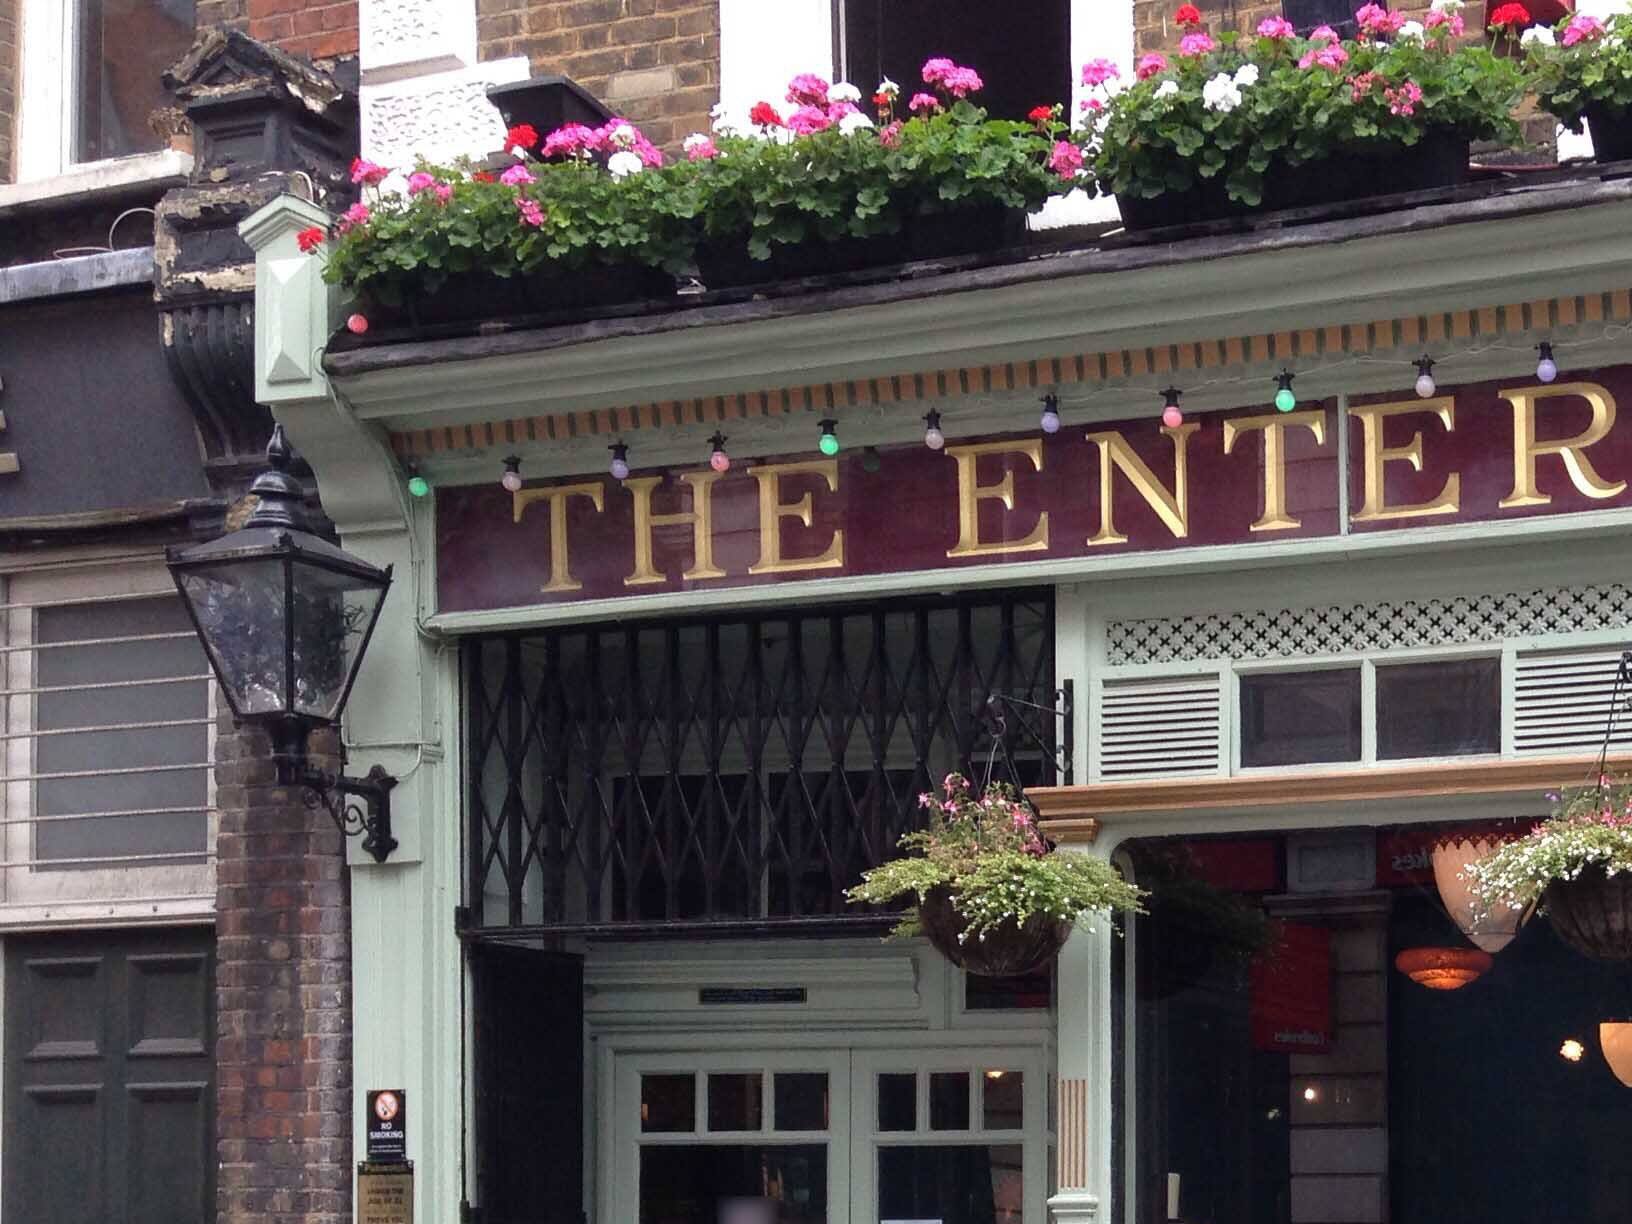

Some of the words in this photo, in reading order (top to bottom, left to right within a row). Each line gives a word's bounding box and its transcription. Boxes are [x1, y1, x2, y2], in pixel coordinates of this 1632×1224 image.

[513, 459, 844, 593] THE
[380, 1122, 393, 1130] NO
[369, 1130, 404, 1139] SMOKING
